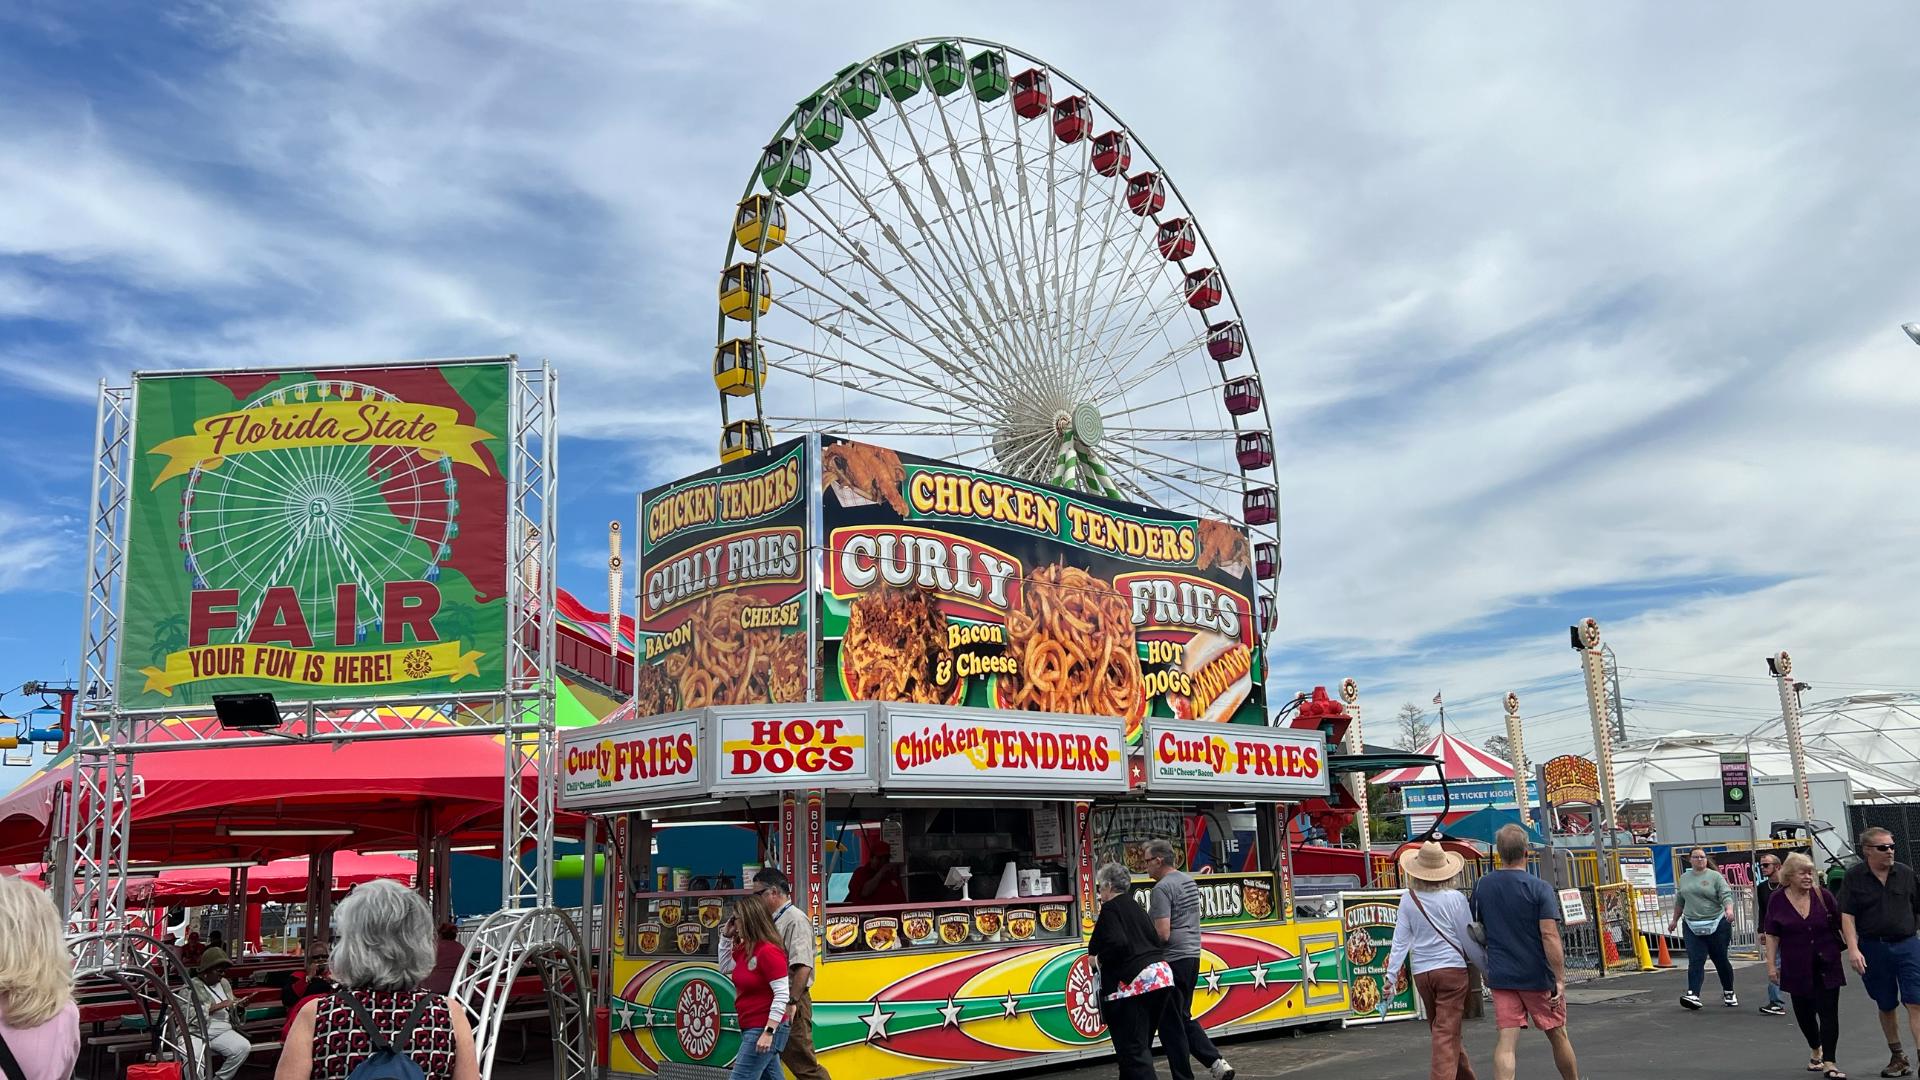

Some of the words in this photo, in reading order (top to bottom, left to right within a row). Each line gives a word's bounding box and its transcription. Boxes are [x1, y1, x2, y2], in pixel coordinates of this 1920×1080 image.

[205, 406, 341, 455] Florida
[342, 404, 438, 444] State
[648, 484, 716, 545] CHICKEN
[720, 457, 799, 521] TENDERS
[910, 472, 1060, 537] CHICKEN
[1066, 504, 1196, 563] TENDERS
[648, 546, 722, 612] CURLY
[727, 534, 799, 583] FRIES
[840, 532, 1014, 609] CURLY
[188, 580, 441, 649] FAIR
[741, 601, 800, 630] CHEESE
[1128, 579, 1241, 638] FRIES
[645, 620, 693, 660] BACON
[948, 624, 1003, 651] Bacon
[1148, 641, 1184, 665] HOT
[190, 647, 245, 679] YOUR
[254, 648, 296, 679] FUN
[303, 653, 324, 682] IS
[334, 654, 392, 684] HERE!
[402, 651, 414, 664] THE
[416, 649, 433, 661] BEST
[403, 665, 432, 679] AROUND
[936, 657, 951, 686] &
[957, 652, 1018, 677] Cheese
[1145, 674, 1192, 700] DOGS
[750, 719, 844, 746] HOT
[895, 721, 980, 771] Chicken
[981, 730, 1110, 771] TENDERS
[568, 743, 611, 776] Curly
[613, 733, 693, 782] FRIES
[731, 746, 854, 775] DOGS
[1159, 732, 1226, 774] Curly
[1235, 741, 1319, 779] FRIES
[1408, 795, 1426, 803] SELF
[1427, 793, 1459, 802] SERVCE
[1461, 792, 1488, 800] TICKET
[1490, 790, 1514, 798] KIOSK
[810, 810, 819, 874] BOTTLE
[1079, 813, 1088, 866] BOTLE
[1278, 812, 1287, 860] BOTLE
[617, 827, 626, 883] BOTLE
[1281, 865, 1292, 904] WATER
[1718, 862, 1754, 887] ECTRIC
[810, 882, 822, 936] WATER
[1081, 873, 1093, 919] WATER
[1199, 884, 1242, 917] FRIES
[1348, 907, 1375, 927] CURLY
[1377, 906, 1397, 923] FRIE
[1068, 961, 1087, 993] THE
[1354, 967, 1367, 975] Chili
[1368, 966, 1386, 974] Cheese
[679, 986, 694, 1014] THE
[695, 984, 718, 1016] BEST
[1394, 1001, 1408, 1009] Fries
[1070, 1006, 1101, 1033] AROU
[679, 1027, 716, 1056] AROUND
